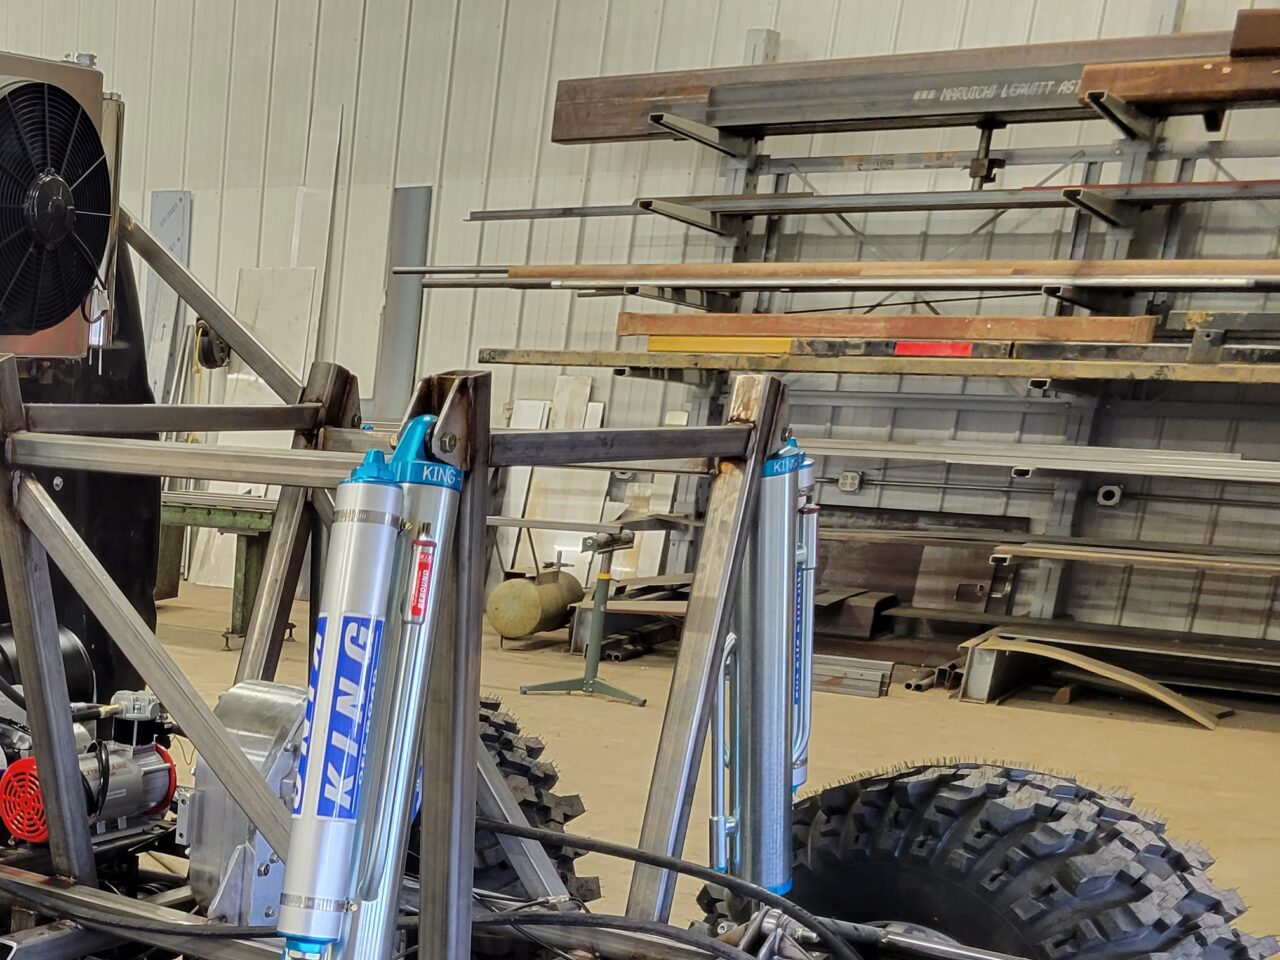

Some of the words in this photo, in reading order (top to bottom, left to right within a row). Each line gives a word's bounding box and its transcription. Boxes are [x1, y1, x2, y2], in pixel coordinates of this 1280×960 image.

[1001, 81, 1055, 98] LEAVITT
[422, 465, 456, 484] KING
[418, 569, 429, 608] REBOUND
[324, 621, 374, 811] KING
